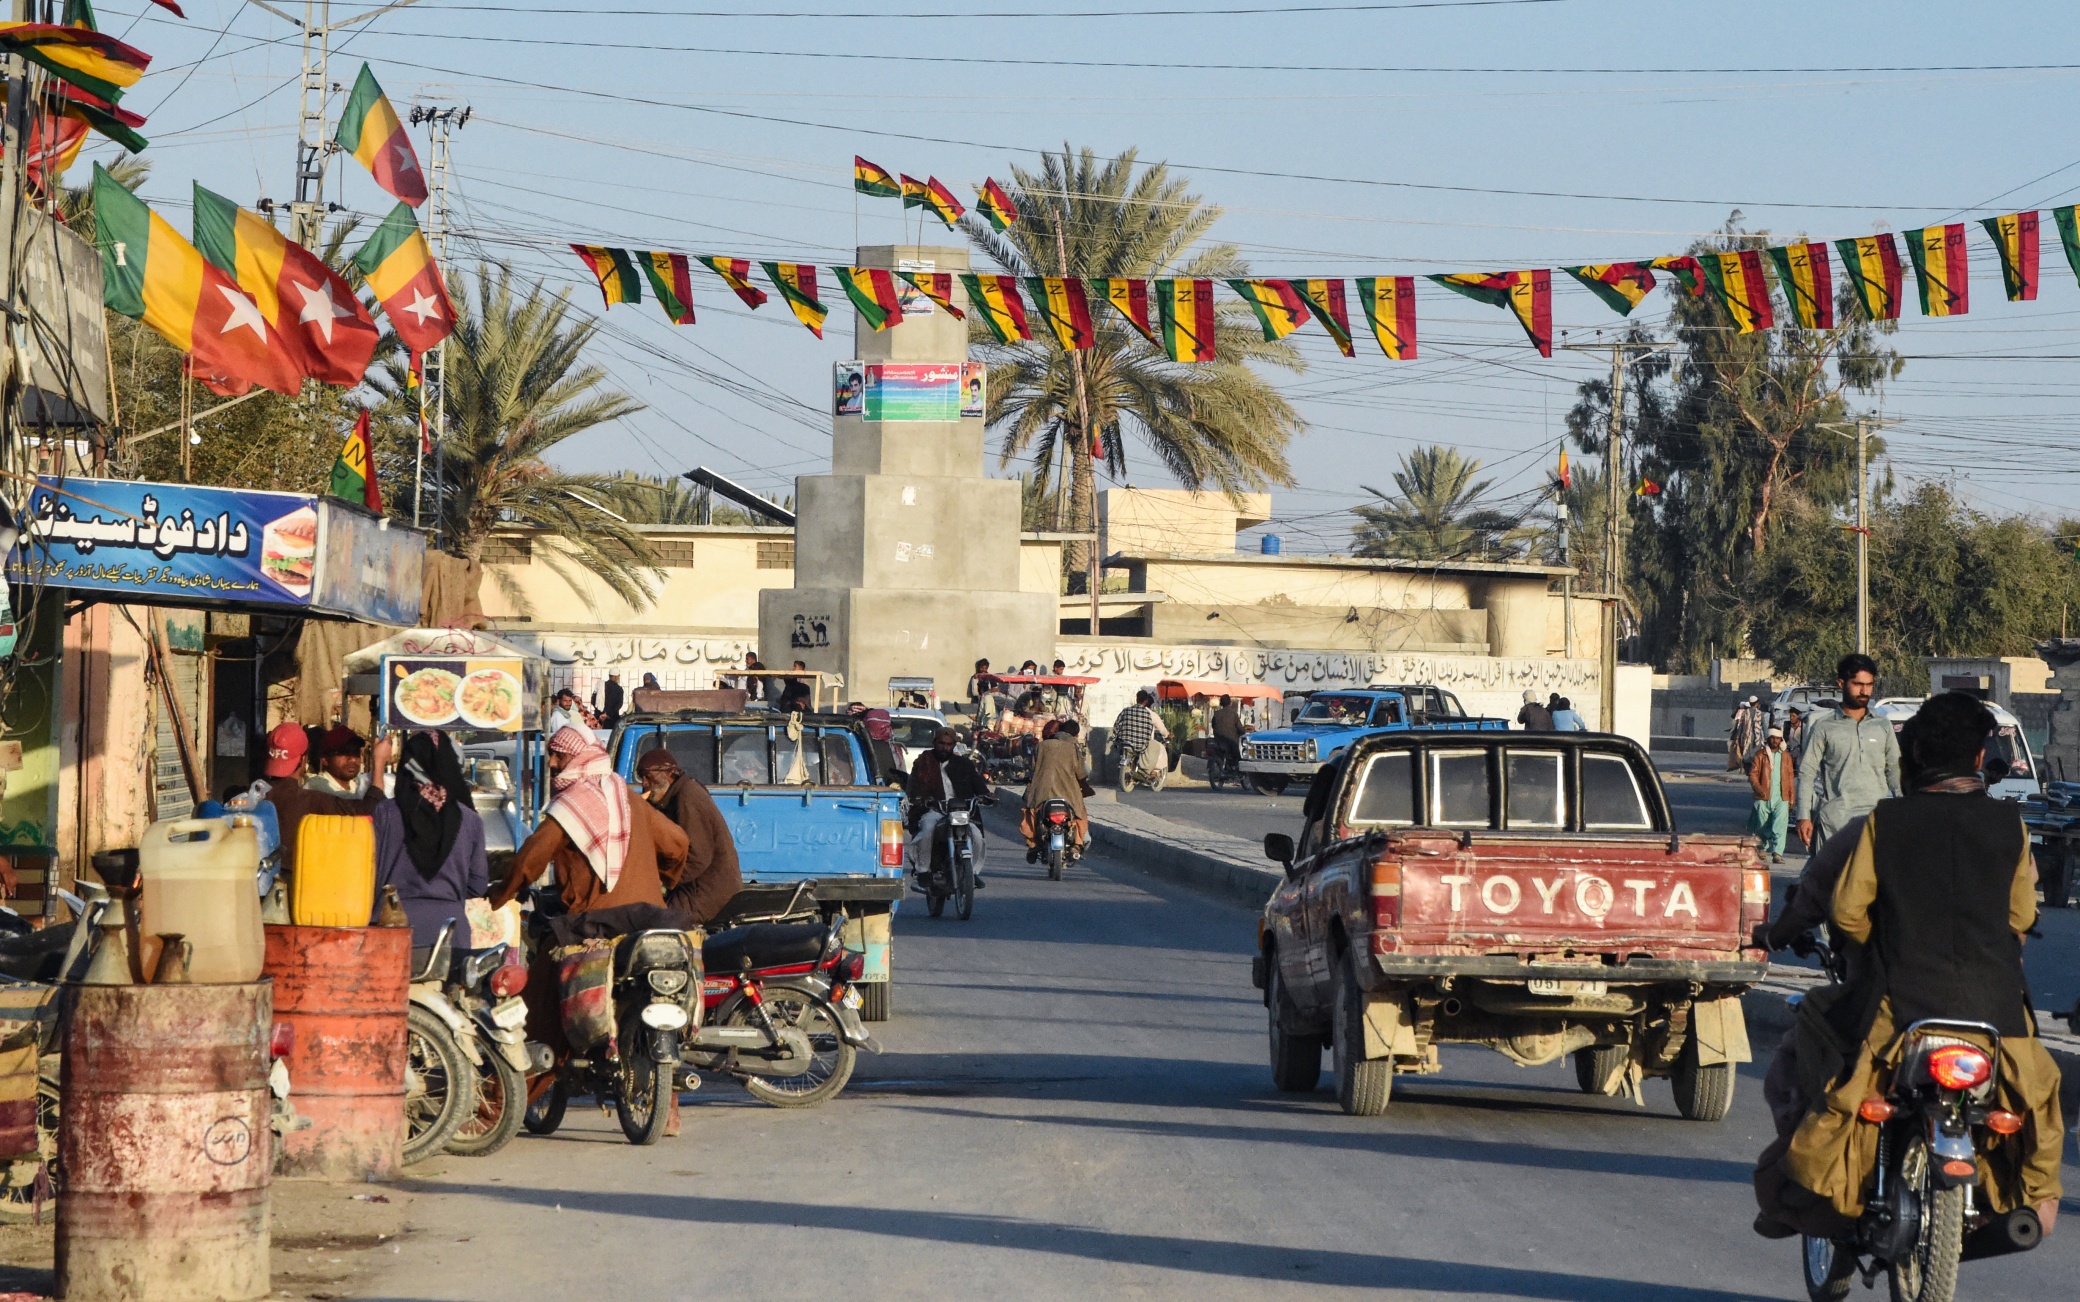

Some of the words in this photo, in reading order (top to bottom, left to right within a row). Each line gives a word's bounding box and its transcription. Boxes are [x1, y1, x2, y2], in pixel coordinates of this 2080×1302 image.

[920, 367, 958, 382] منشور
[137, 493, 195, 560] فوڈ
[196, 511, 249, 557] داد
[49, 559, 66, 577] بھی
[65, 567, 75, 580] پر
[75, 562, 94, 578] آرڈر
[92, 563, 106, 580] مال
[122, 567, 158, 585] تقریبات
[190, 573, 211, 588] شادی
[211, 577, 231, 590] یہاں
[231, 579, 259, 590] ہمارے
[1440, 874, 1699, 918] TOYOTA
[642, 936, 684, 944] HONDA
